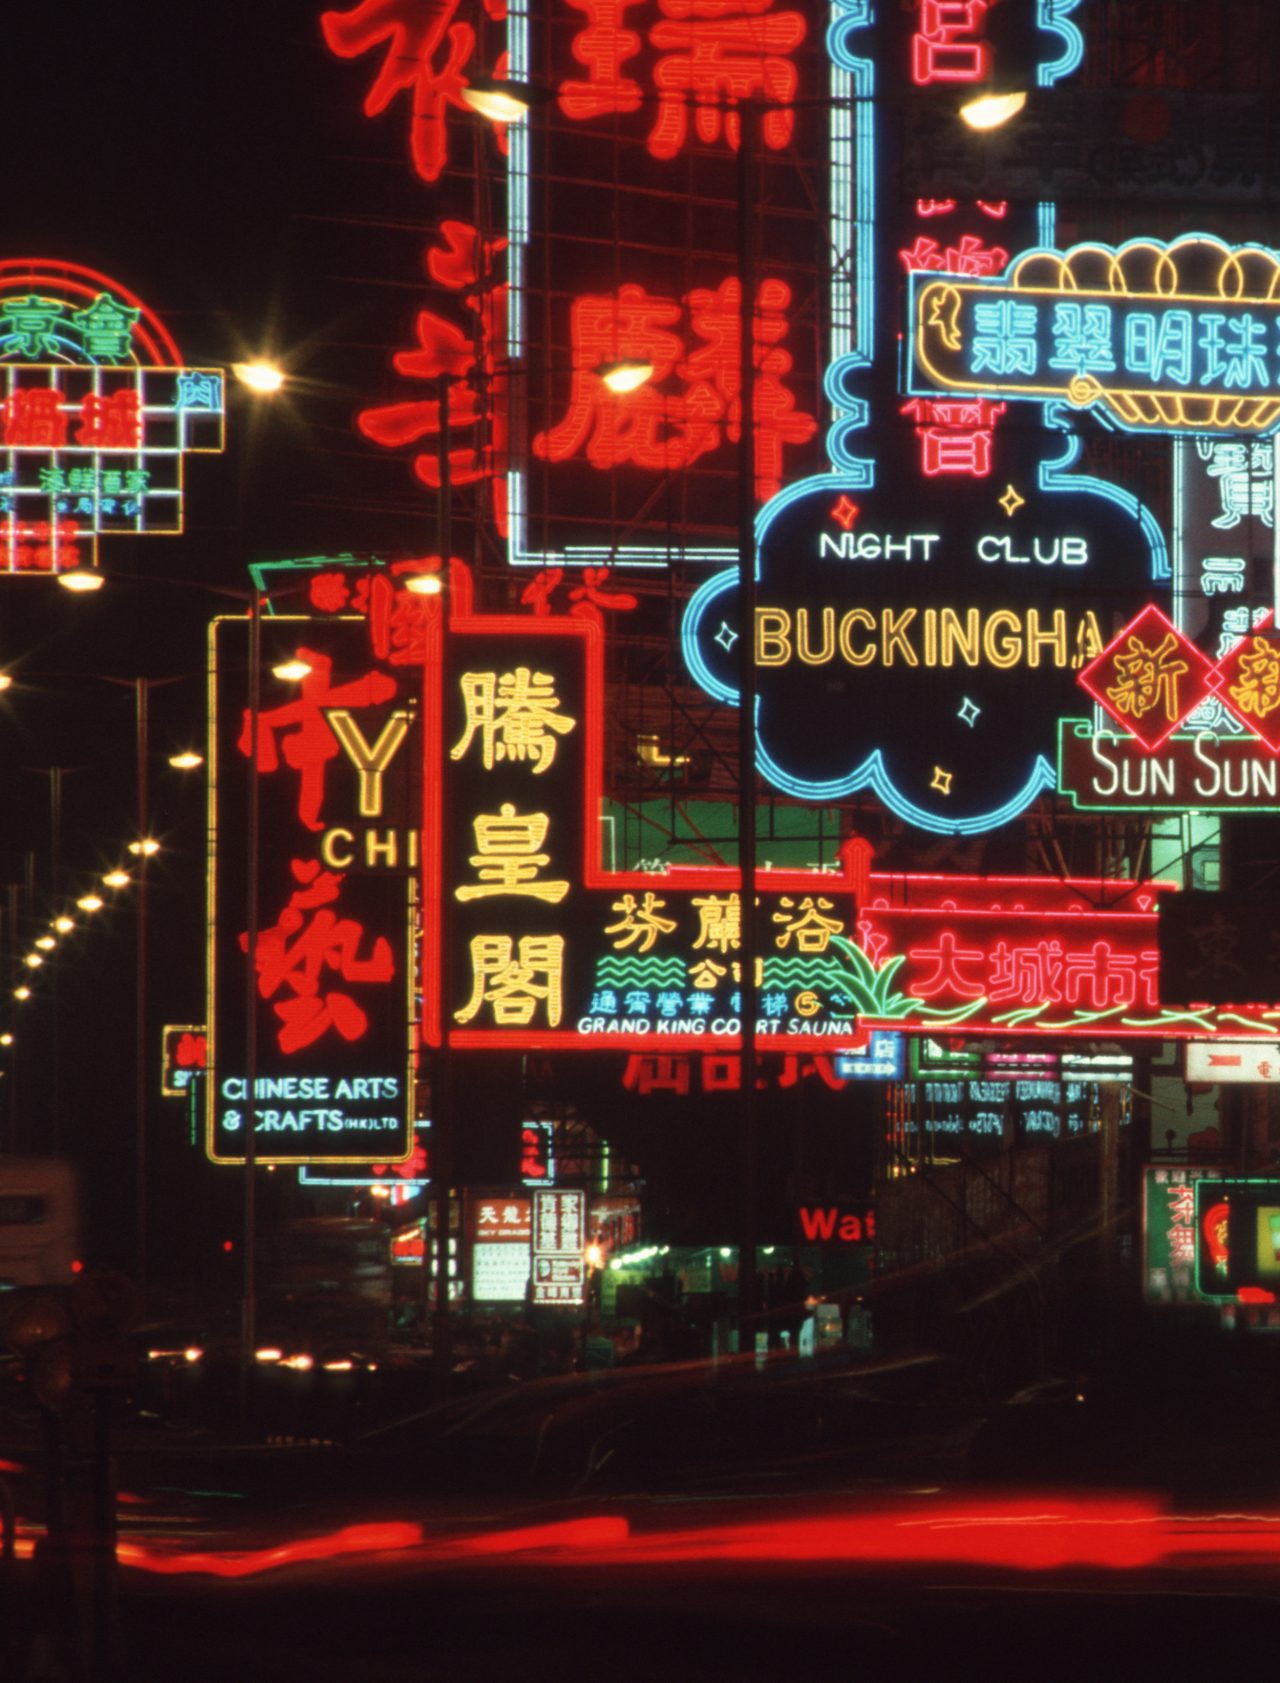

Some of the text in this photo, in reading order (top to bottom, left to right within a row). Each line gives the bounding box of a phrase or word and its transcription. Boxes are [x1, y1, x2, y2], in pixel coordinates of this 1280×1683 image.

[818, 532, 1089, 565] NIGHT CLUB
[754, 606, 1105, 669] BUCKINGHA
[1092, 731, 1175, 796] SUN
[1193, 731, 1277, 797] SUN
[450, 666, 577, 1028] 騰皇閣
[577, 1017, 854, 1036] GRAND KING CORT SAUNA
[335, 1077, 399, 1100] ARTS
[222, 1109, 242, 1131] &
